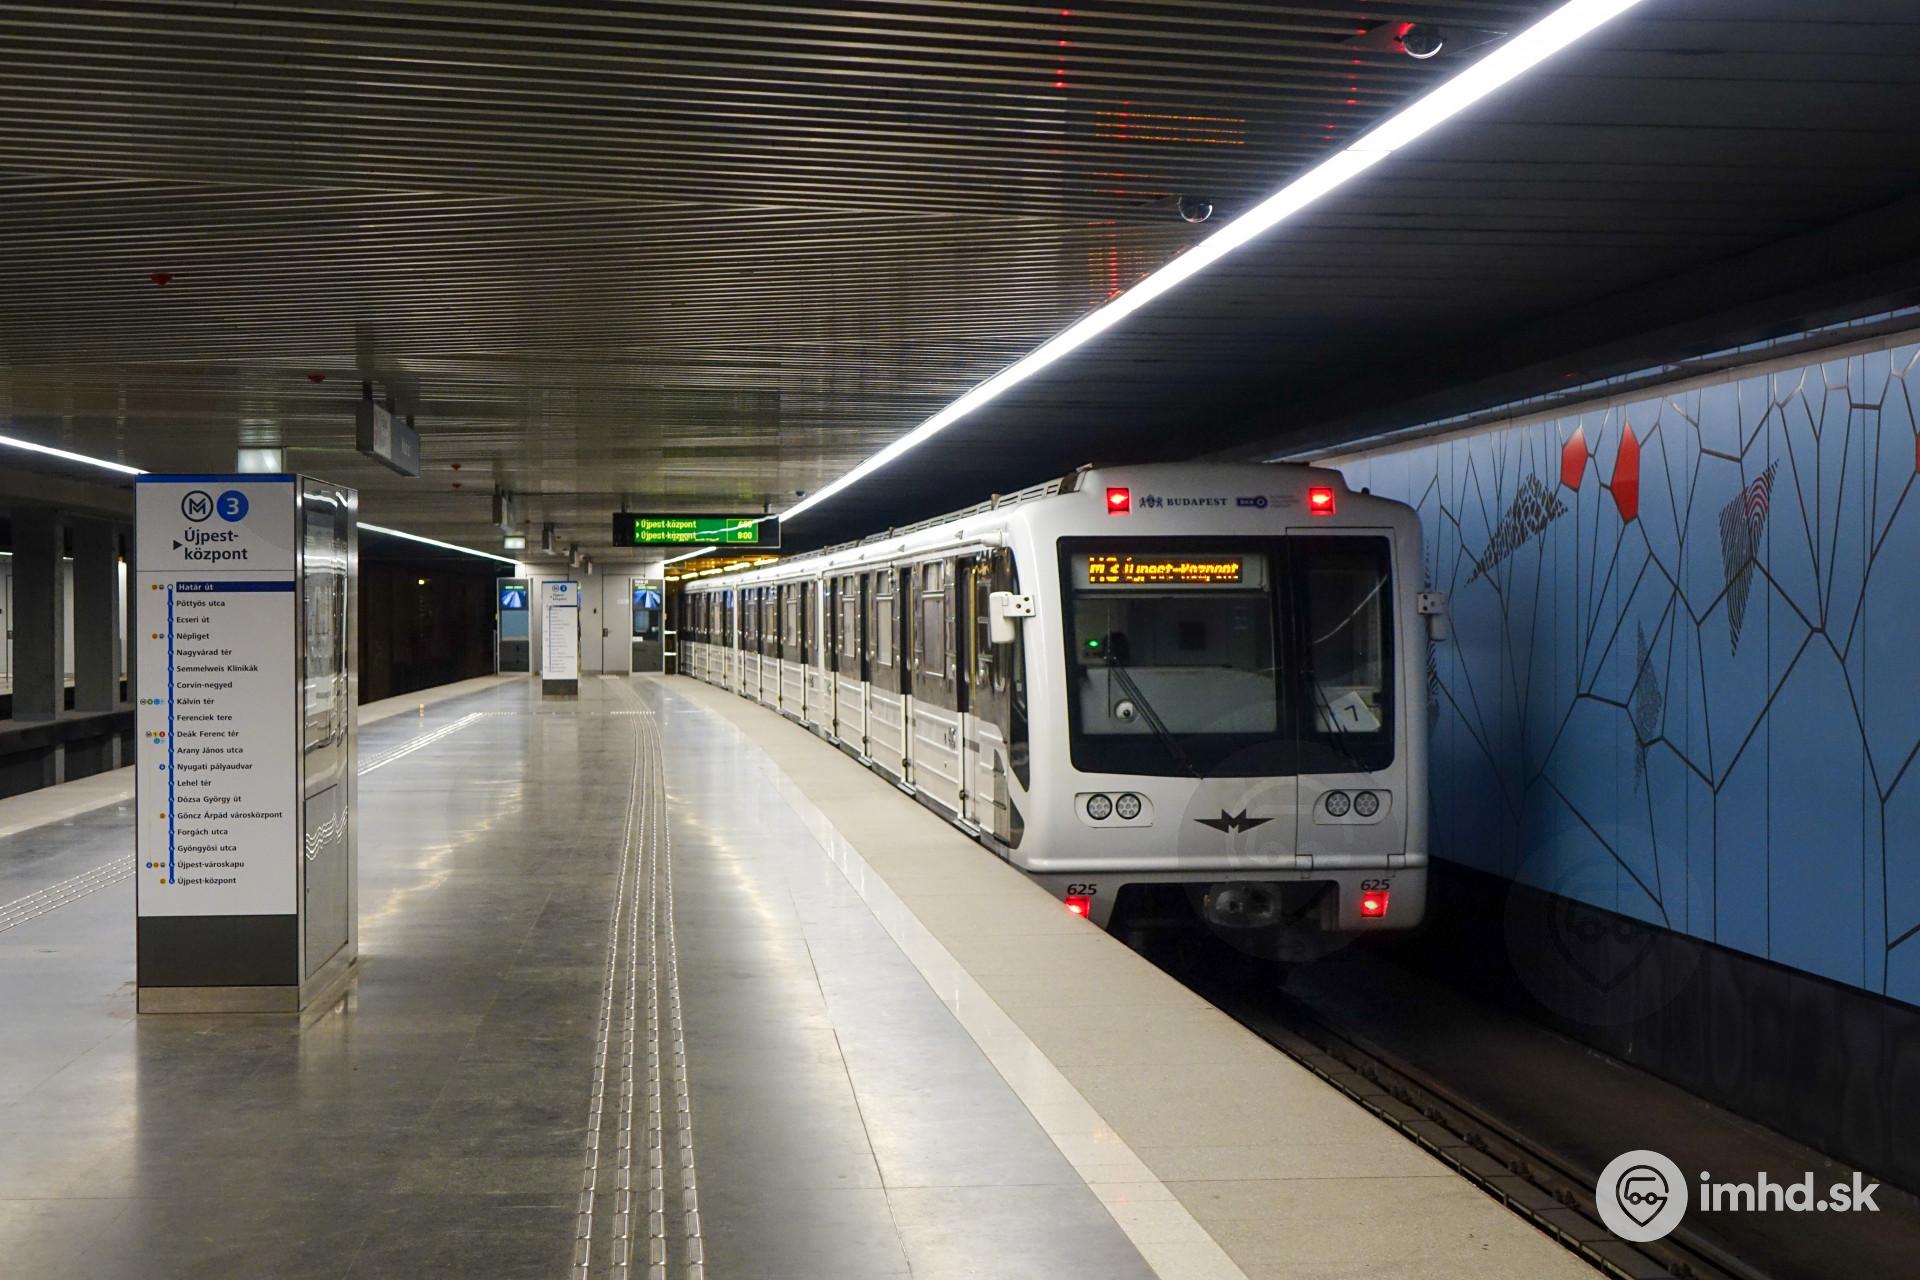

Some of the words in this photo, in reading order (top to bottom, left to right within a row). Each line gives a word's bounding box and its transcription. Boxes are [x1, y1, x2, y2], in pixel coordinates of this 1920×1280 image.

[226, 497, 240, 515] 3
[1166, 497, 1228, 507] BUDAPEST
[184, 526, 239, 545] Újpest-
[184, 547, 248, 563] központ
[178, 583, 202, 591] Határ
[204, 583, 214, 591] út
[176, 599, 206, 608] Pöttyös
[176, 615, 199, 624] Ecseri
[201, 615, 210, 624] út
[176, 632, 210, 642] Népliget
[176, 648, 219, 658] Nagyvárad
[220, 648, 233, 656] tér
[176, 664, 225, 673] Semmelweis
[226, 664, 259, 672] Klinikák
[176, 680, 233, 691] Corvin-negyed
[176, 697, 201, 705] Kálvin
[202, 697, 215, 705] tér
[176, 713, 215, 722] Ferenciek
[176, 730, 197, 738] Deák
[199, 730, 226, 738] Ferenc
[227, 729, 239, 738] tér
[176, 746, 201, 756] Arany
[202, 746, 224, 755] János
[176, 762, 208, 773] Nyugati
[210, 762, 253, 773] pályaudvar
[177, 778, 199, 787] Lehel
[200, 779, 212, 787] tér
[177, 795, 201, 804] Dózsa
[203, 795, 231, 805] György
[233, 795, 242, 803] út
[177, 811, 202, 820] Göncz
[204, 810, 228, 821] Árpád
[230, 811, 283, 821] városközpont
[177, 827, 209, 838] Forgách
[211, 828, 229, 836] utca
[177, 843, 218, 854] Gyöngyösi
[219, 844, 237, 852] utca
[177, 858, 245, 871] Újpest-városkapu
[177, 875, 237, 887] Újpest-központ
[1360, 879, 1391, 892] 625
[1067, 883, 1097, 896] 625
